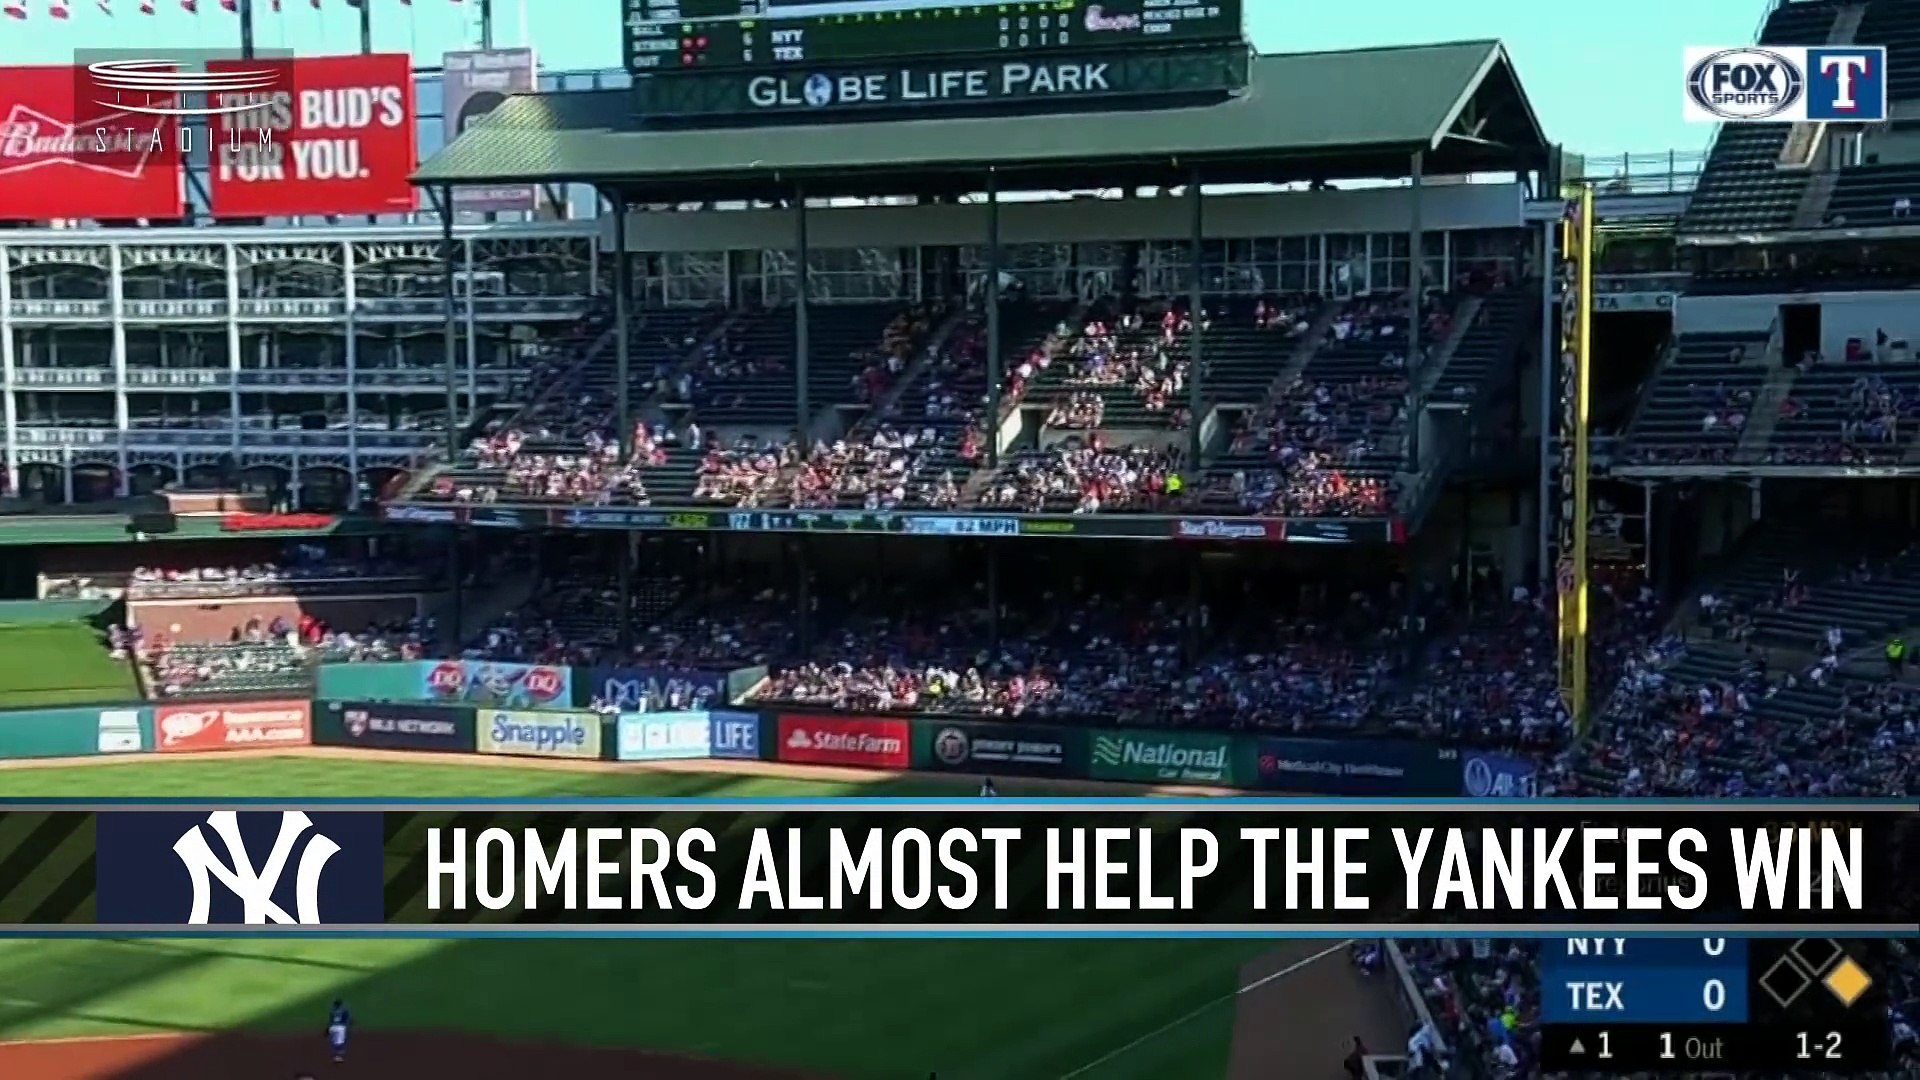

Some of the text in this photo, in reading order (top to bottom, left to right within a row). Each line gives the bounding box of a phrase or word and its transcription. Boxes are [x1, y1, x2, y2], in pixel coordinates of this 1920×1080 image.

[901, 70, 988, 100] LIFE
[1001, 64, 1109, 95] PARK
[300, 86, 404, 129] BUD'S
[218, 138, 371, 182] FOR YOU.
[432, 669, 464, 692] DQ
[527, 674, 560, 693] DQ
[491, 713, 586, 750] Snapple
[715, 719, 756, 751] LIFE
[1122, 741, 1228, 769] National
